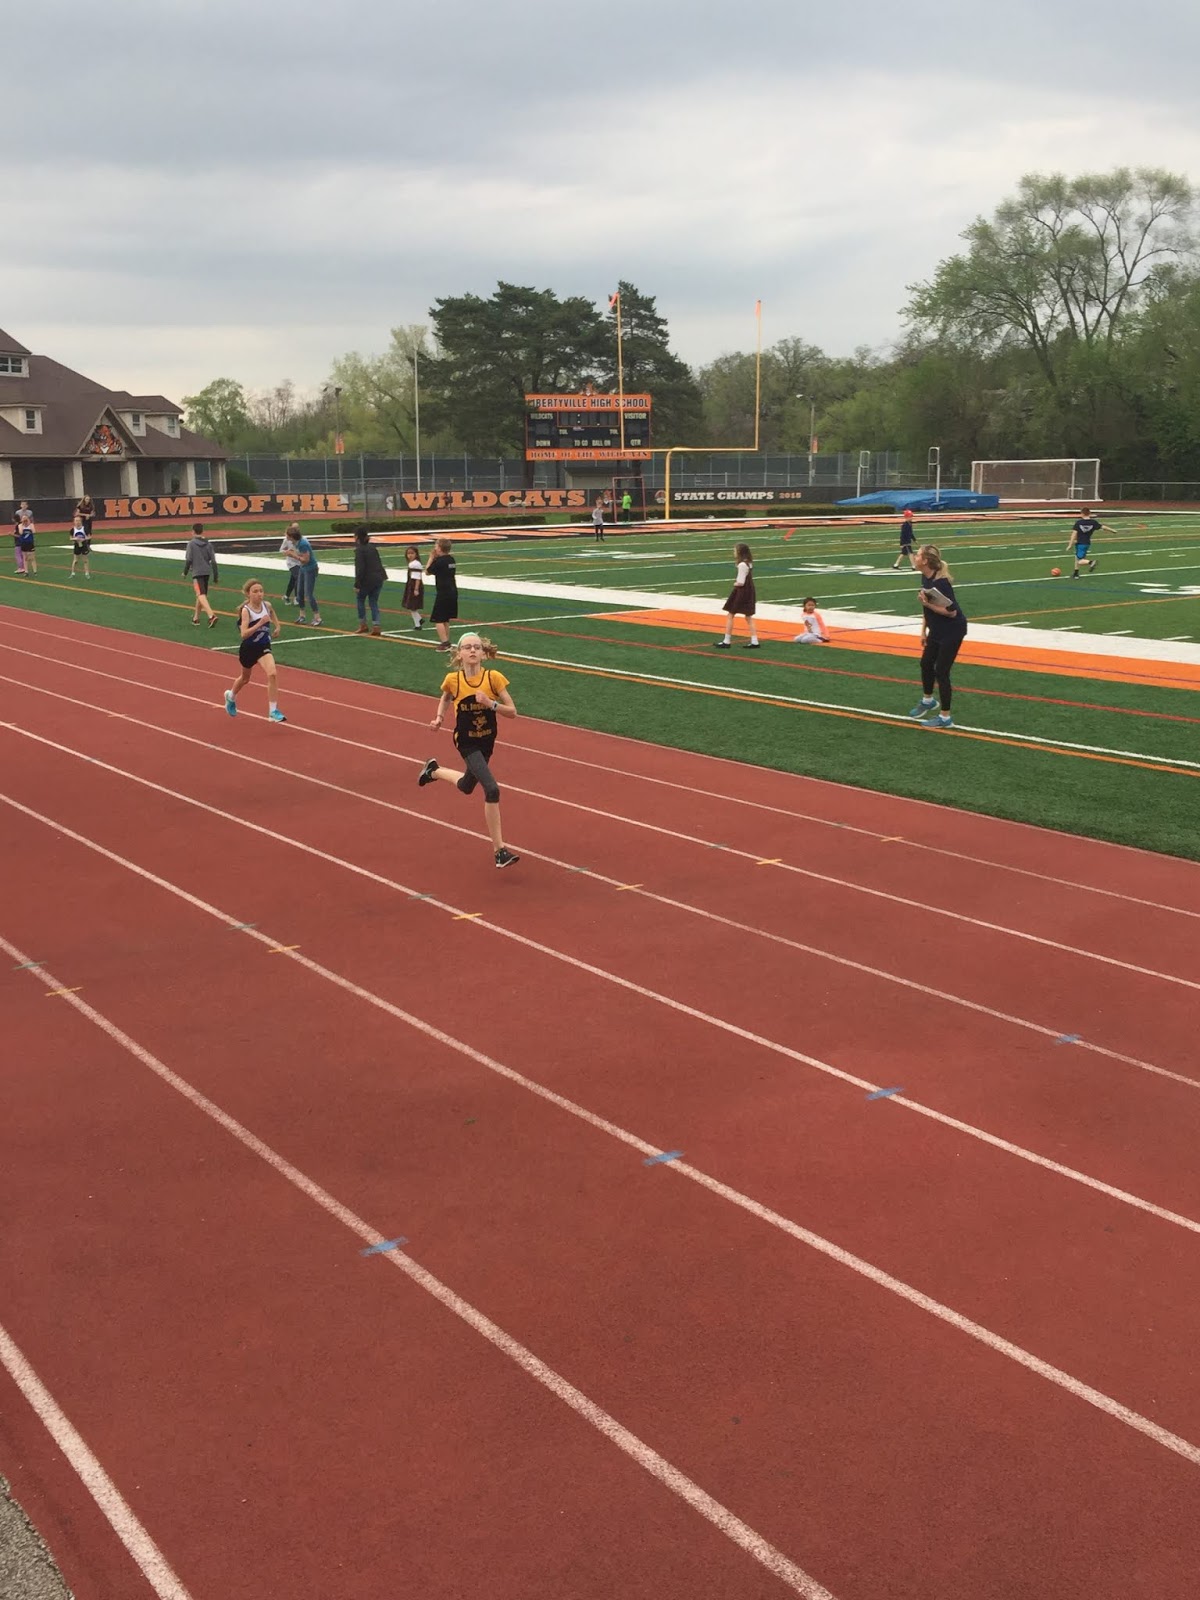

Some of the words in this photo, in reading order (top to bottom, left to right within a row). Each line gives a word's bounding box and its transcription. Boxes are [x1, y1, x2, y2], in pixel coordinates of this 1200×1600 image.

[590, 398, 611, 408] HIGH
[614, 398, 648, 408] SCHOOL
[401, 490, 586, 509] WILDCATS
[674, 492, 715, 501] STATE
[717, 491, 774, 500] CHAMPS
[104, 496, 214, 518] HOME
[222, 495, 271, 513] OF
[276, 494, 348, 512] THE
